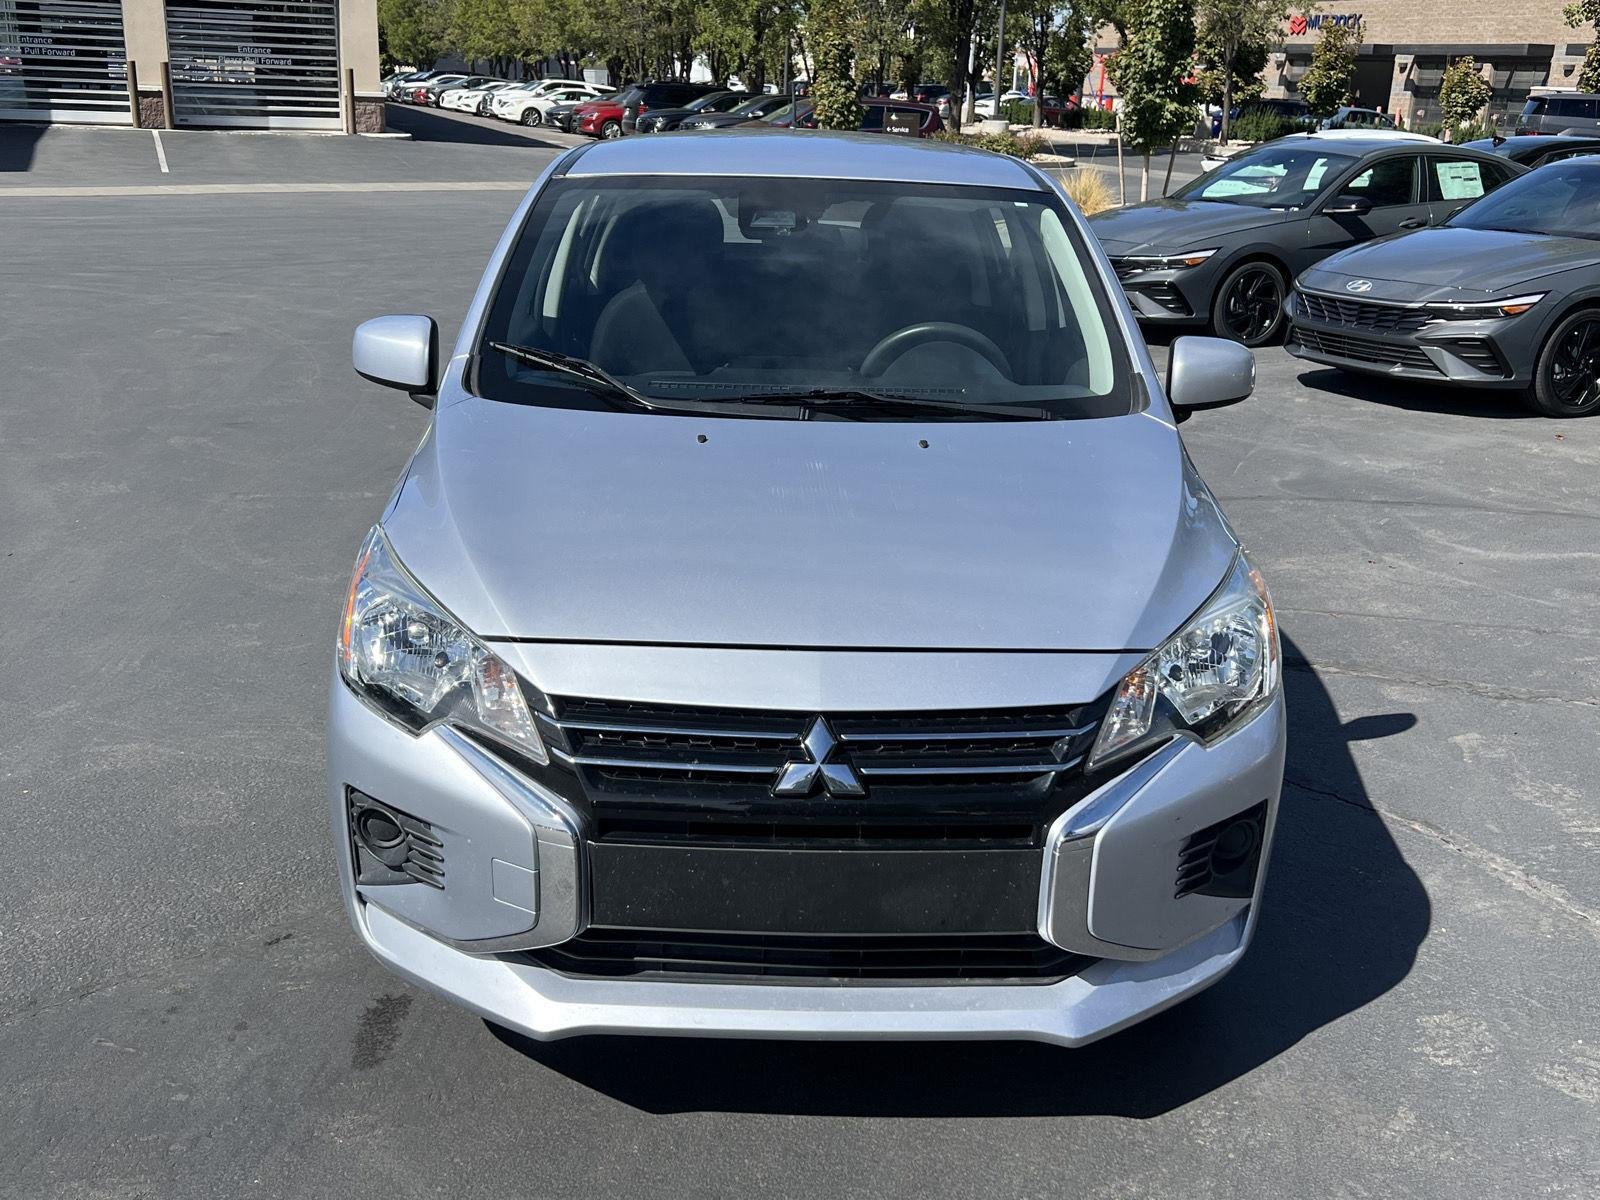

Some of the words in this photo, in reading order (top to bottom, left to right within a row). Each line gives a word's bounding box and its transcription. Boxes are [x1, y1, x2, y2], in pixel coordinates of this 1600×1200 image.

[16, 36, 53, 45] Entrance
[24, 47, 40, 55] Pull
[42, 48, 76, 56] Forward
[237, 45, 272, 54] Entrance
[261, 57, 292, 66] Forward
